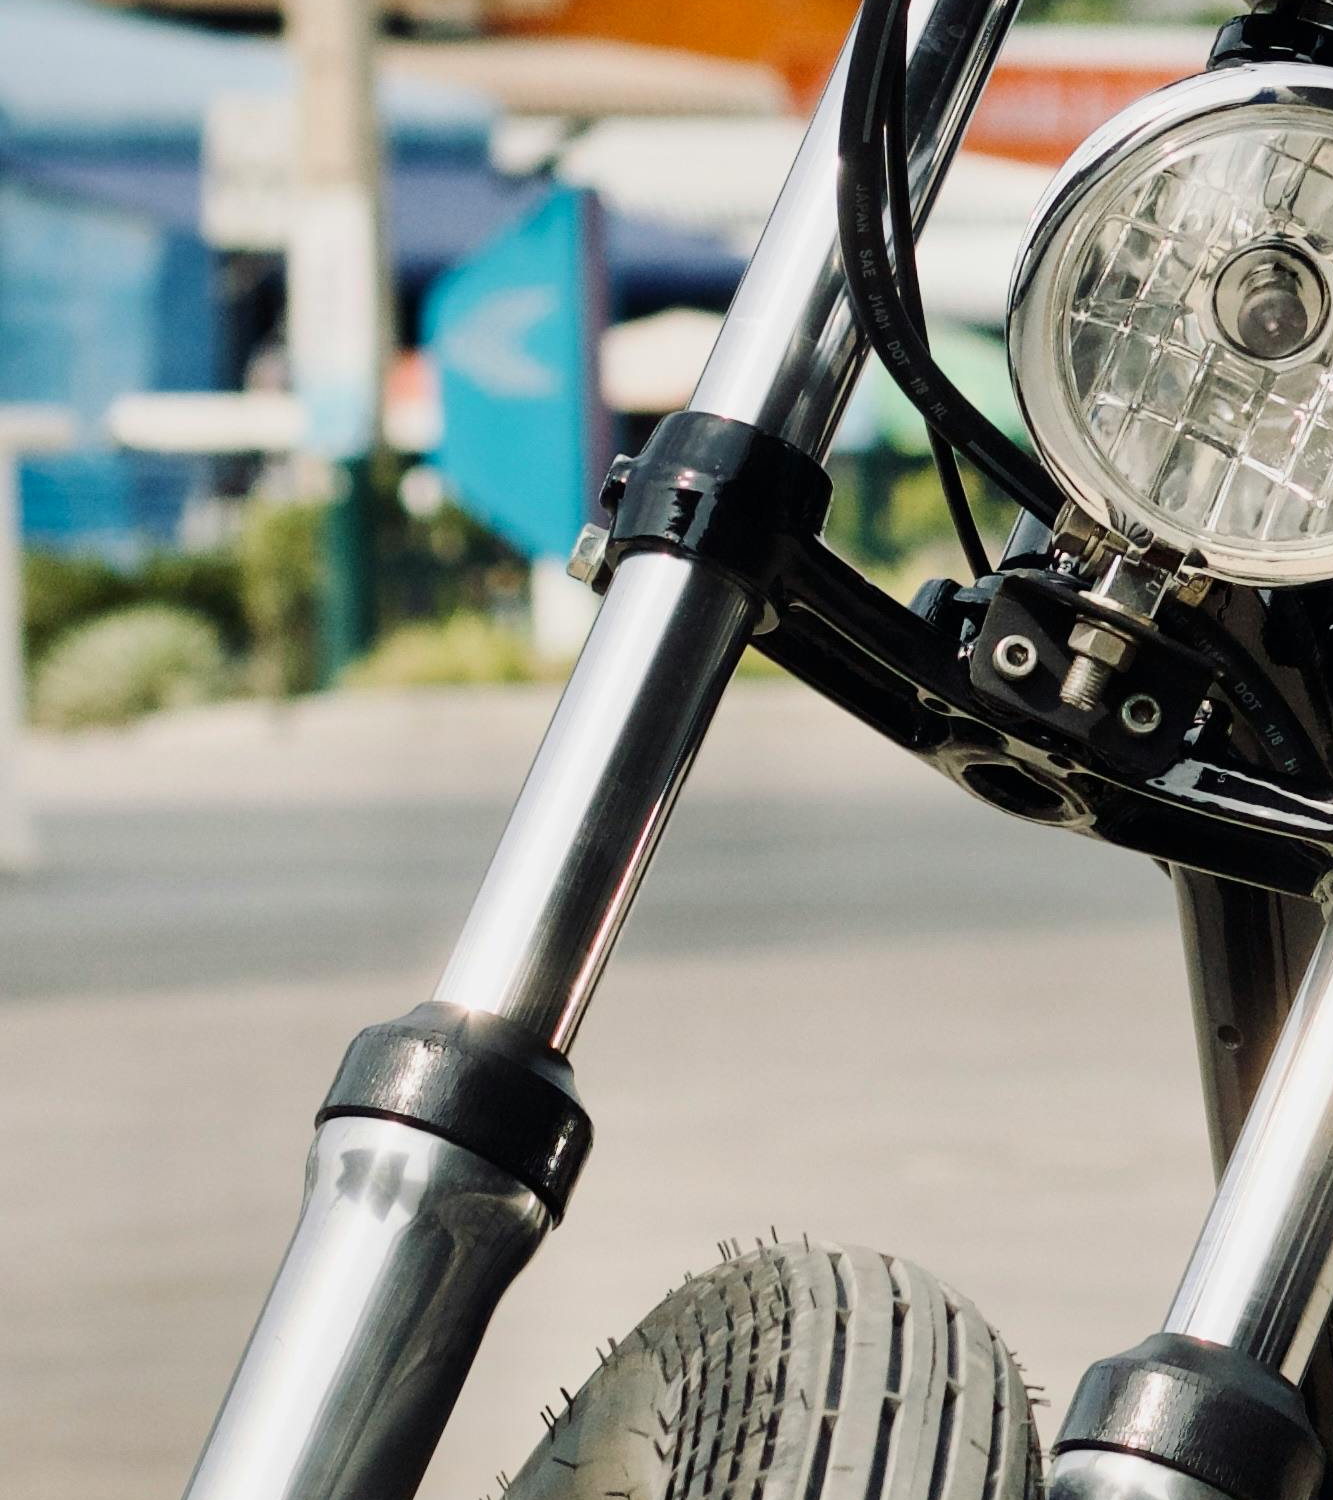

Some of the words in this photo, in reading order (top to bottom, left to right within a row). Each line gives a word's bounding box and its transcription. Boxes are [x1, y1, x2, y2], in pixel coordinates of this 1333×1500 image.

[855, 183, 869, 234] JAPAN
[859, 249, 877, 278] SAE
[887, 340, 910, 367] DOT
[1234, 681, 1262, 711] DOT
[1264, 723, 1284, 747] 1/8
